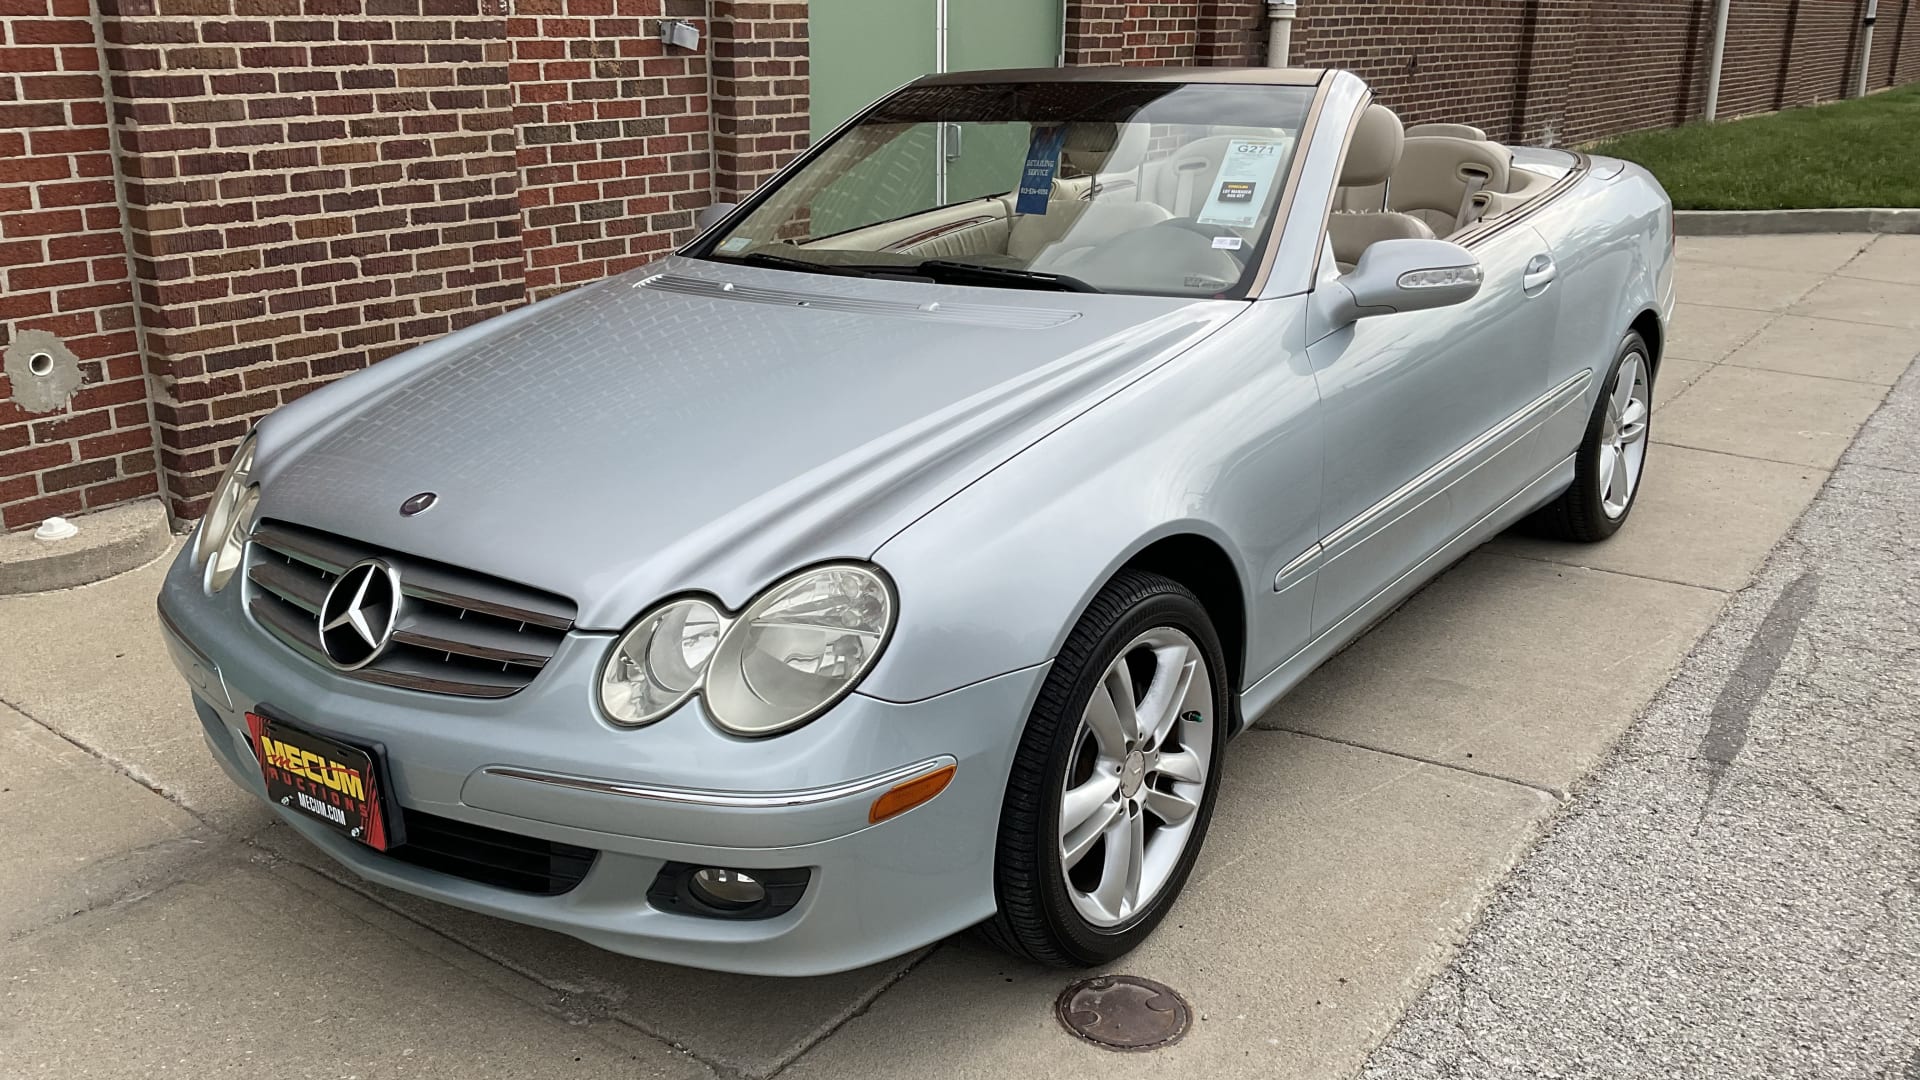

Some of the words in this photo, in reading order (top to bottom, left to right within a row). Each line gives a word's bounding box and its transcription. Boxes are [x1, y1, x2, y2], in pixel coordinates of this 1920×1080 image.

[1026, 160, 1054, 168] DETAILING
[1238, 145, 1274, 154] G271
[261, 735, 365, 801] MECUM
[269, 767, 368, 817] AUCTIONS
[298, 791, 346, 825] MECUM.COM
